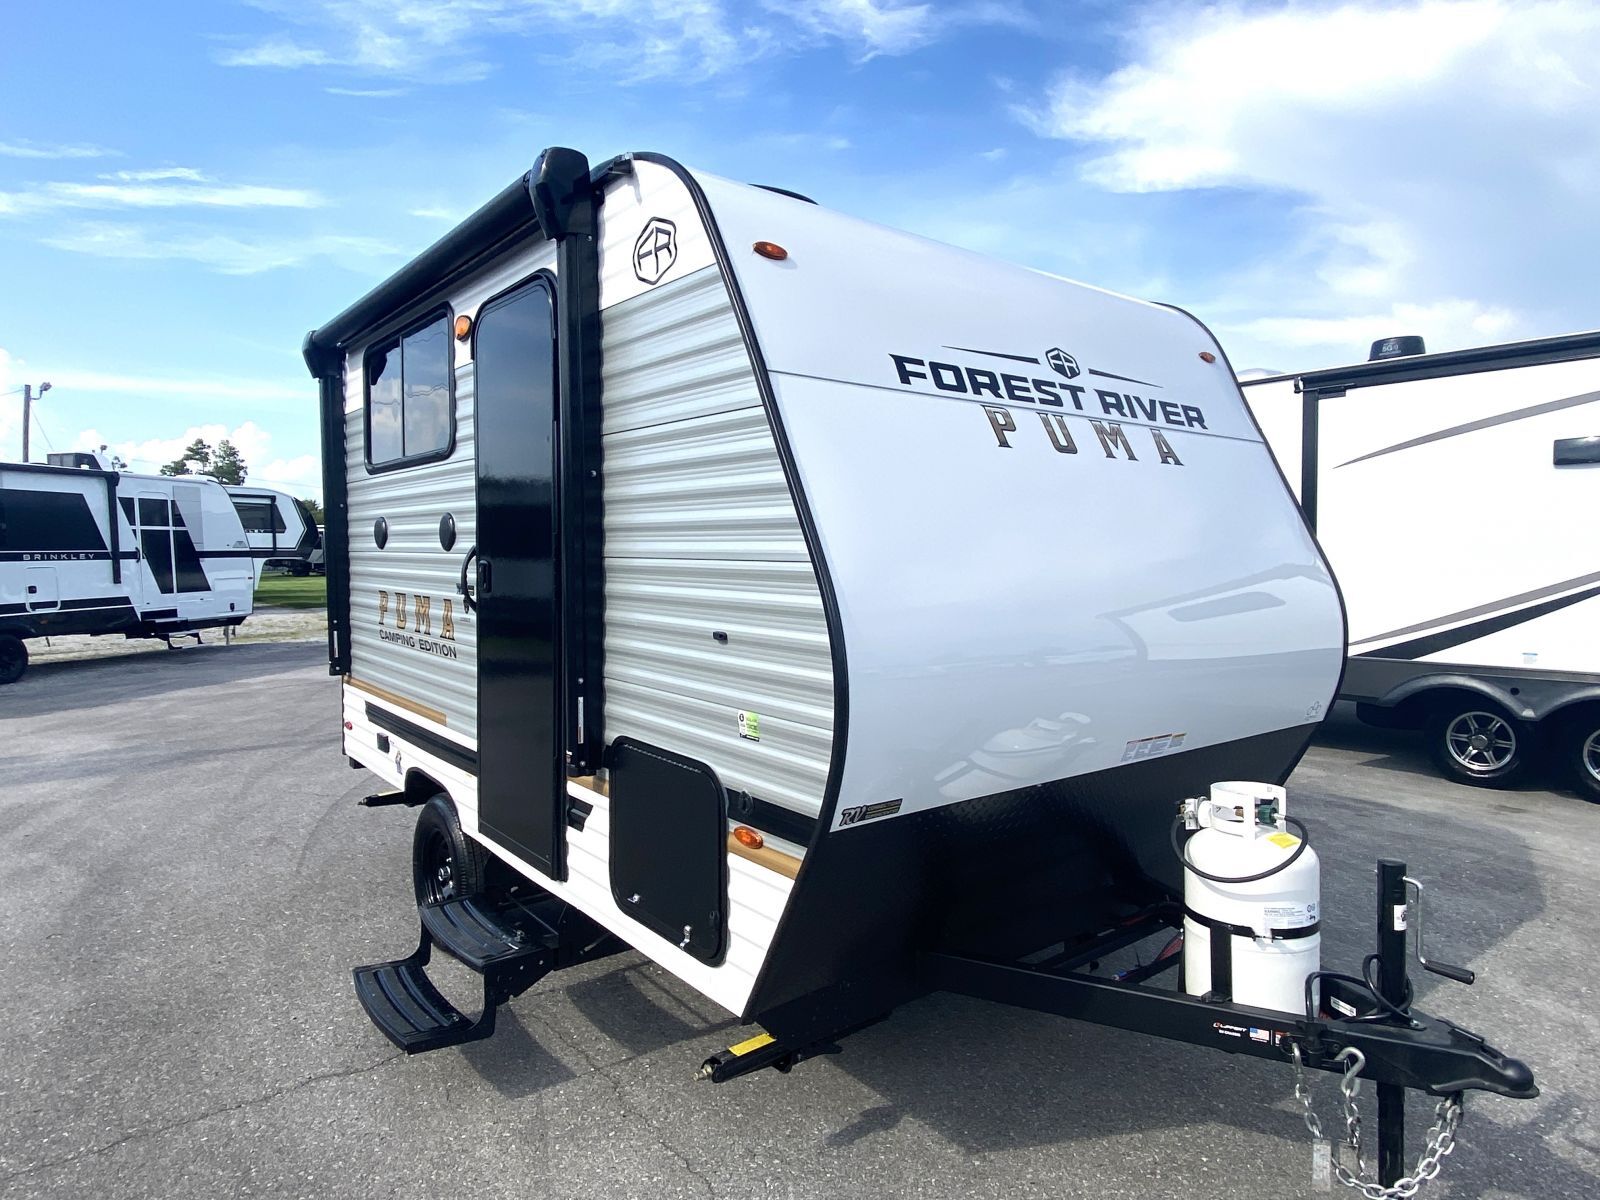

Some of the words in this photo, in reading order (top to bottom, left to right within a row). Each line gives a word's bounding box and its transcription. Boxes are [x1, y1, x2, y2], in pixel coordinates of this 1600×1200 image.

[888, 353, 1085, 410] FOREST
[1093, 388, 1208, 430] RIVER
[980, 404, 1184, 466] PUMA
[378, 590, 455, 640] PUMA
[379, 629, 415, 647] CAMPING
[419, 639, 457, 658] EDITION
[840, 805, 867, 826] RV
